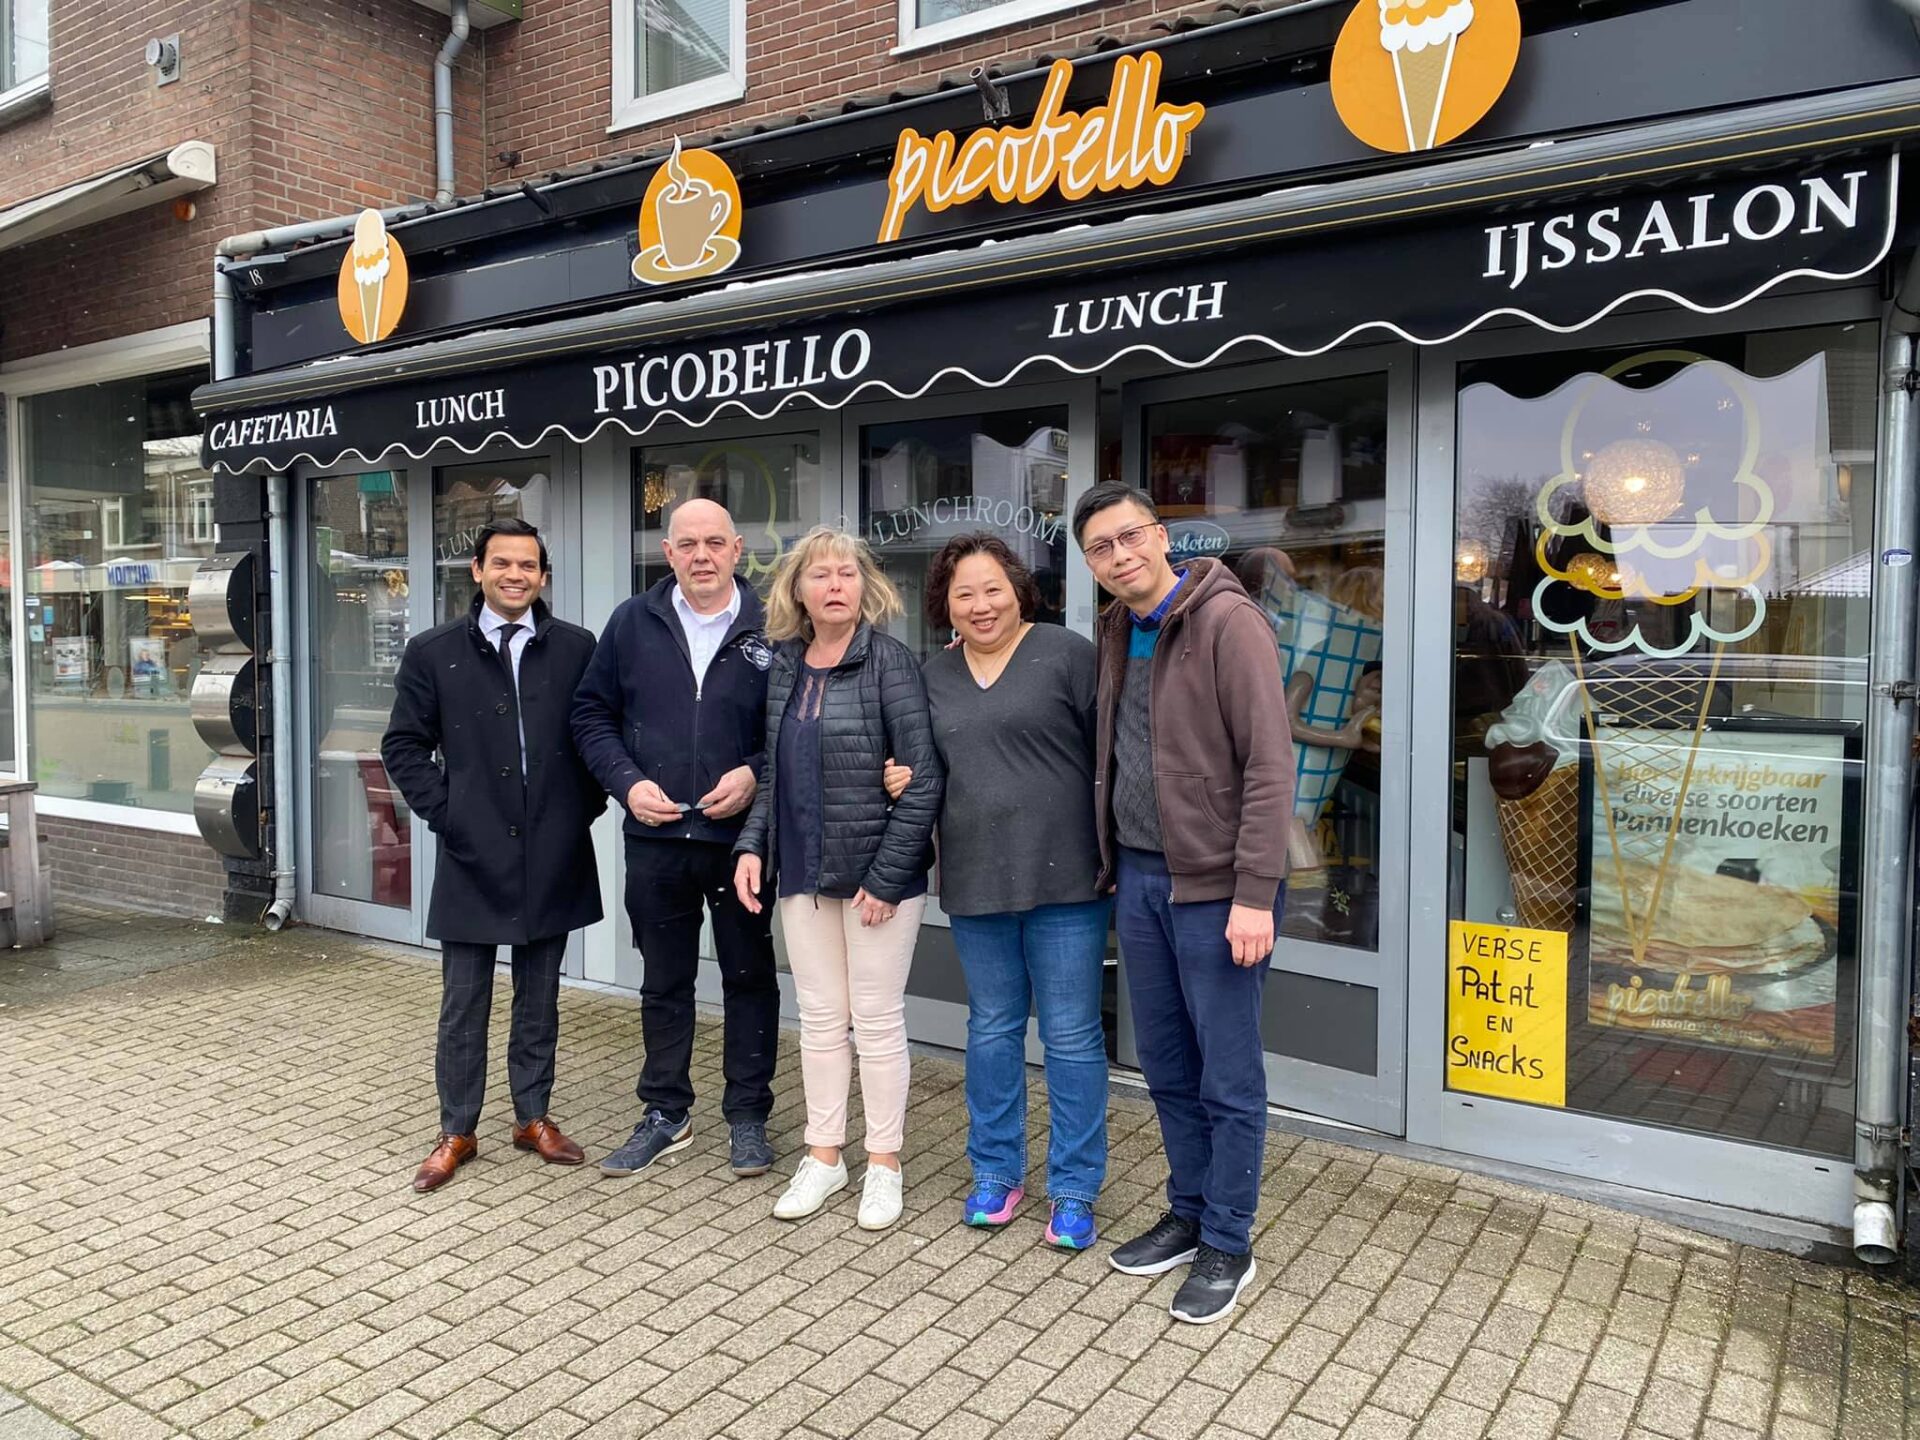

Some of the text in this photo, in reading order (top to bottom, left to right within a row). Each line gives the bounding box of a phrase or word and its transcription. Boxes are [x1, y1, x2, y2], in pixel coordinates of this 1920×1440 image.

[878, 51, 1206, 243] picobello
[1482, 171, 1867, 290] IJSSALON
[249, 269, 263, 286] 18
[1048, 281, 1228, 339] LUNCH
[593, 329, 871, 413] PICOBELLO
[209, 405, 338, 451] CAFETARIA
[415, 389, 506, 429] LUNCH
[874, 496, 1062, 546] LUNCHROOM
[1168, 533, 1225, 553] esloten
[1623, 783, 1818, 814] diverse soorten
[1612, 807, 1829, 843] Pannenkoeken
[1463, 932, 1543, 962] VERSE
[1487, 1015, 1513, 1033] EN
